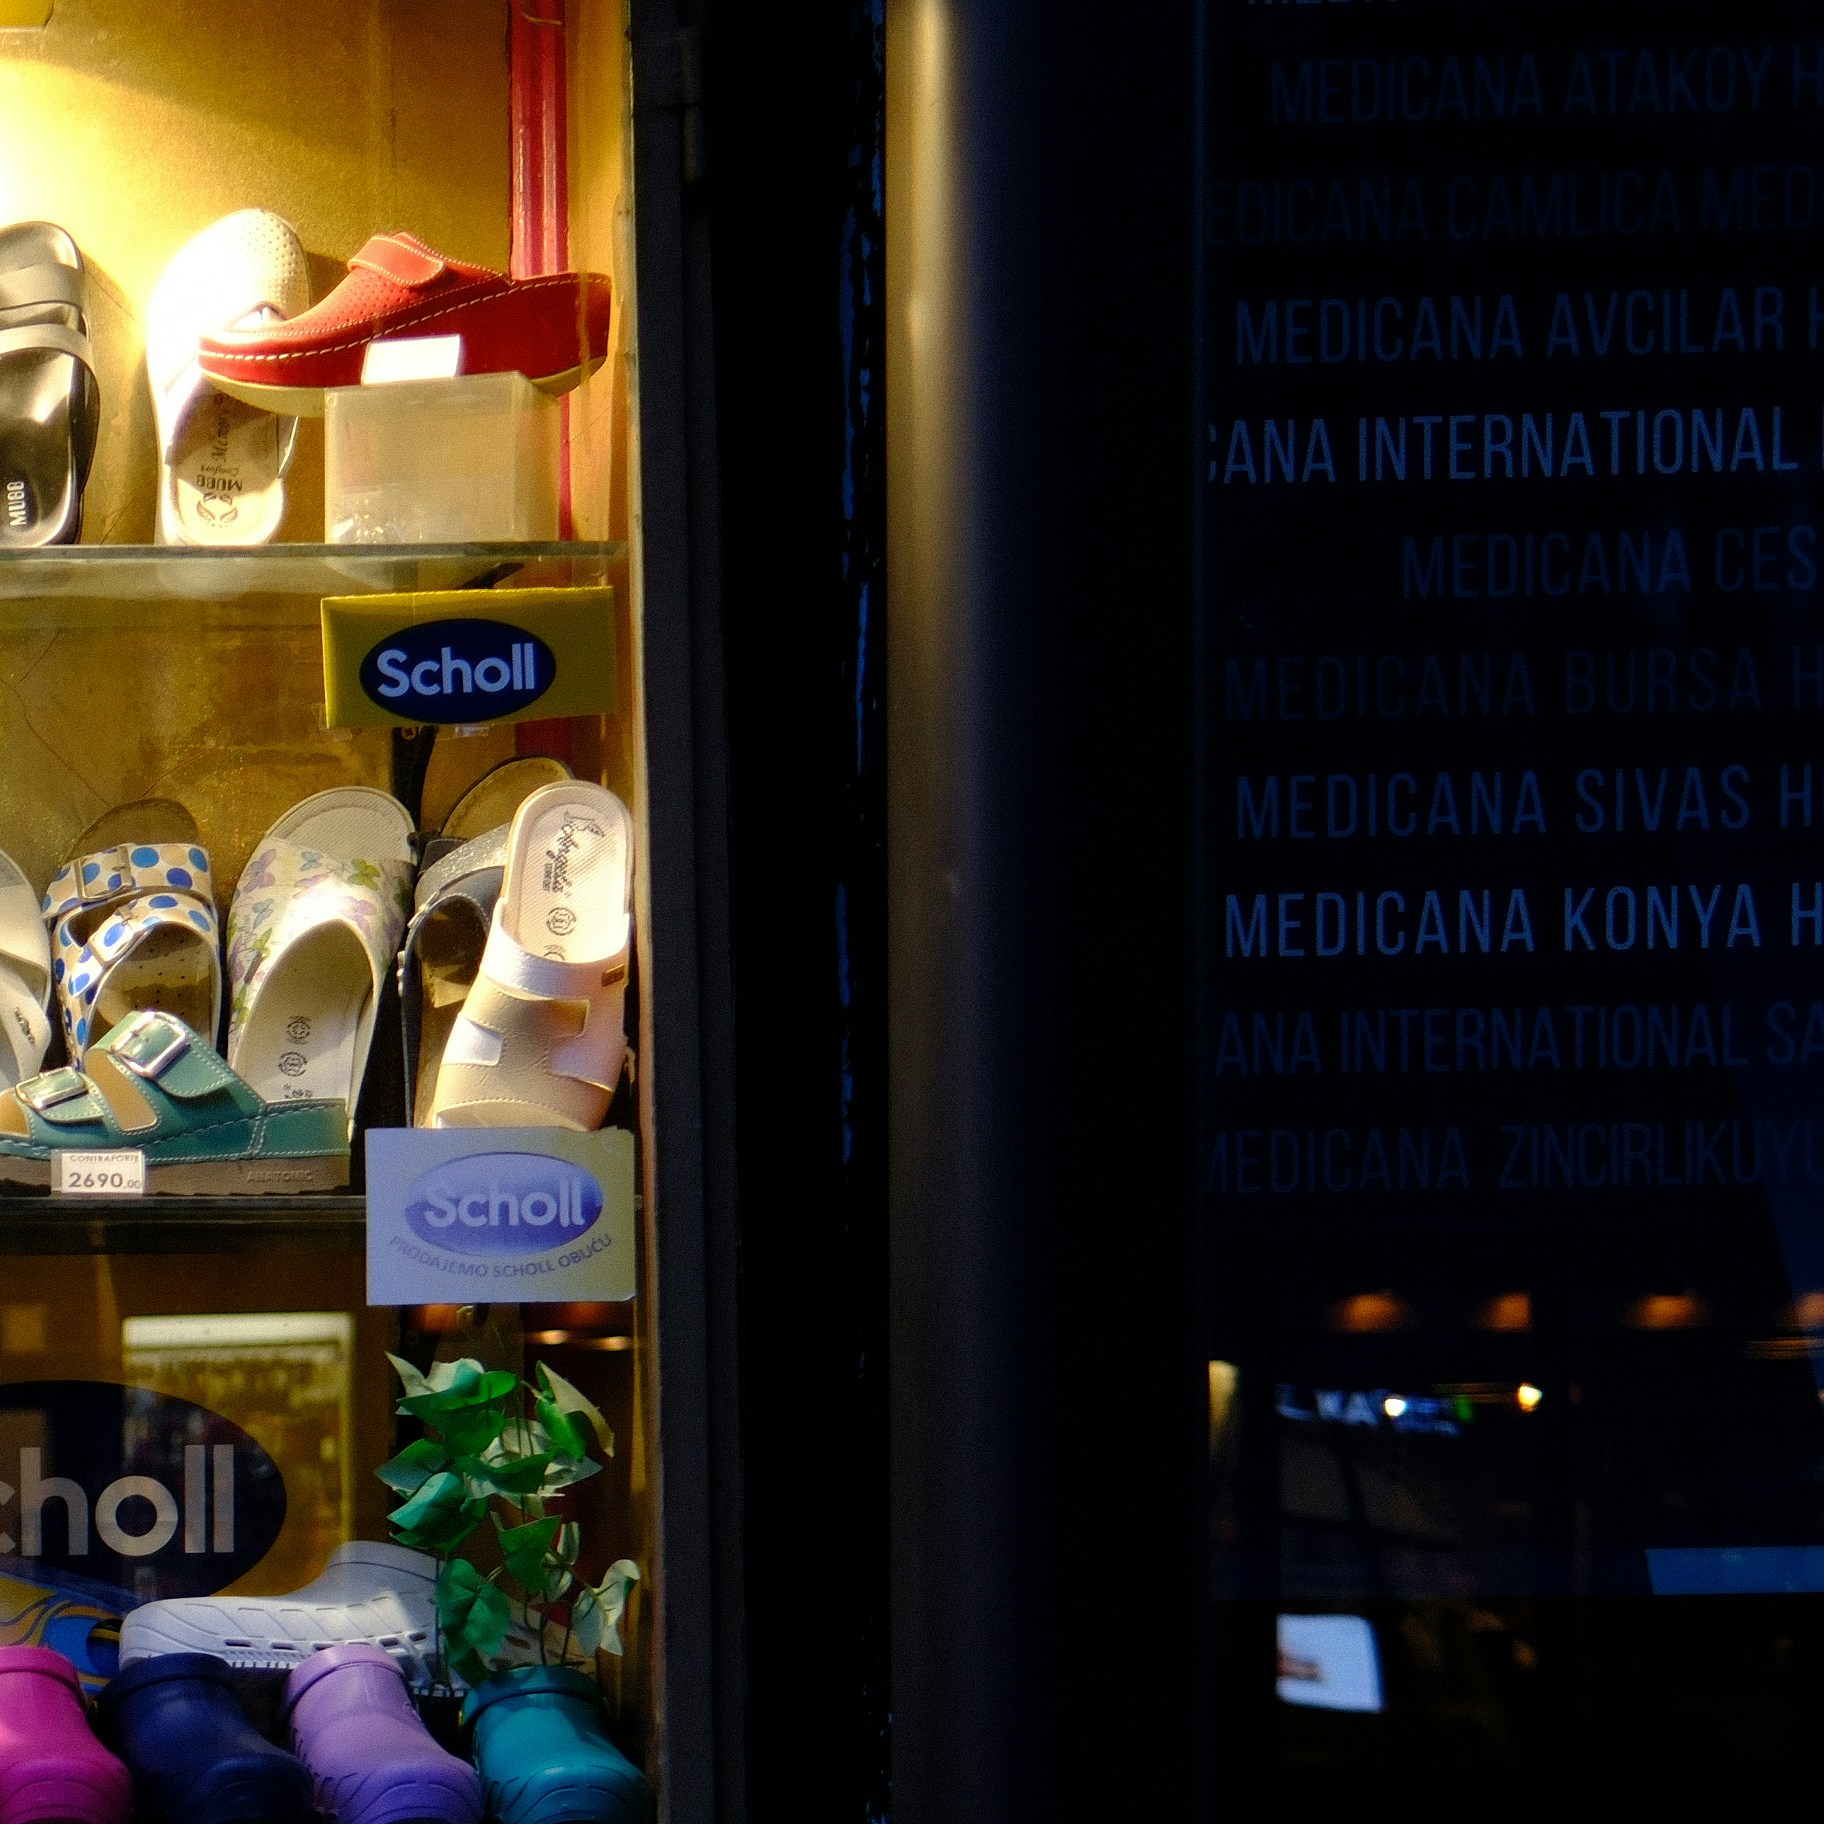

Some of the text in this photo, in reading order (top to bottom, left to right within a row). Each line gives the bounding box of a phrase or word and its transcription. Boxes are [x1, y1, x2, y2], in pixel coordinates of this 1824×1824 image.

[1271, 53, 1545, 125] MEDICANA
[1563, 43, 1774, 115] ATAKOY
[1448, 169, 1682, 241] CAMLICA
[1235, 292, 1524, 365] MEDICANA
[1547, 286, 1785, 361] AVCILAR
[1357, 405, 1799, 482] INTERNATIONAL
[6, 481, 27, 526] MUBB
[196, 474, 243, 491] MUBB
[1402, 527, 1692, 602] MEDICANA
[377, 643, 535, 698] Scholl
[1225, 652, 1537, 721] MEDICANA
[1566, 647, 1763, 718] BURSA
[1236, 770, 1548, 840] MEDICANA
[1575, 764, 1753, 835] SIVAS
[1225, 888, 1537, 959] MEDICANA
[1565, 883, 1763, 951] KONYA
[1341, 1003, 1750, 1076] INTERNATIONAL
[69, 1153, 140, 1163] CONTRAFORTE
[424, 1178, 586, 1228] Scholl
[493, 1261, 556, 1278] SCHOLL
